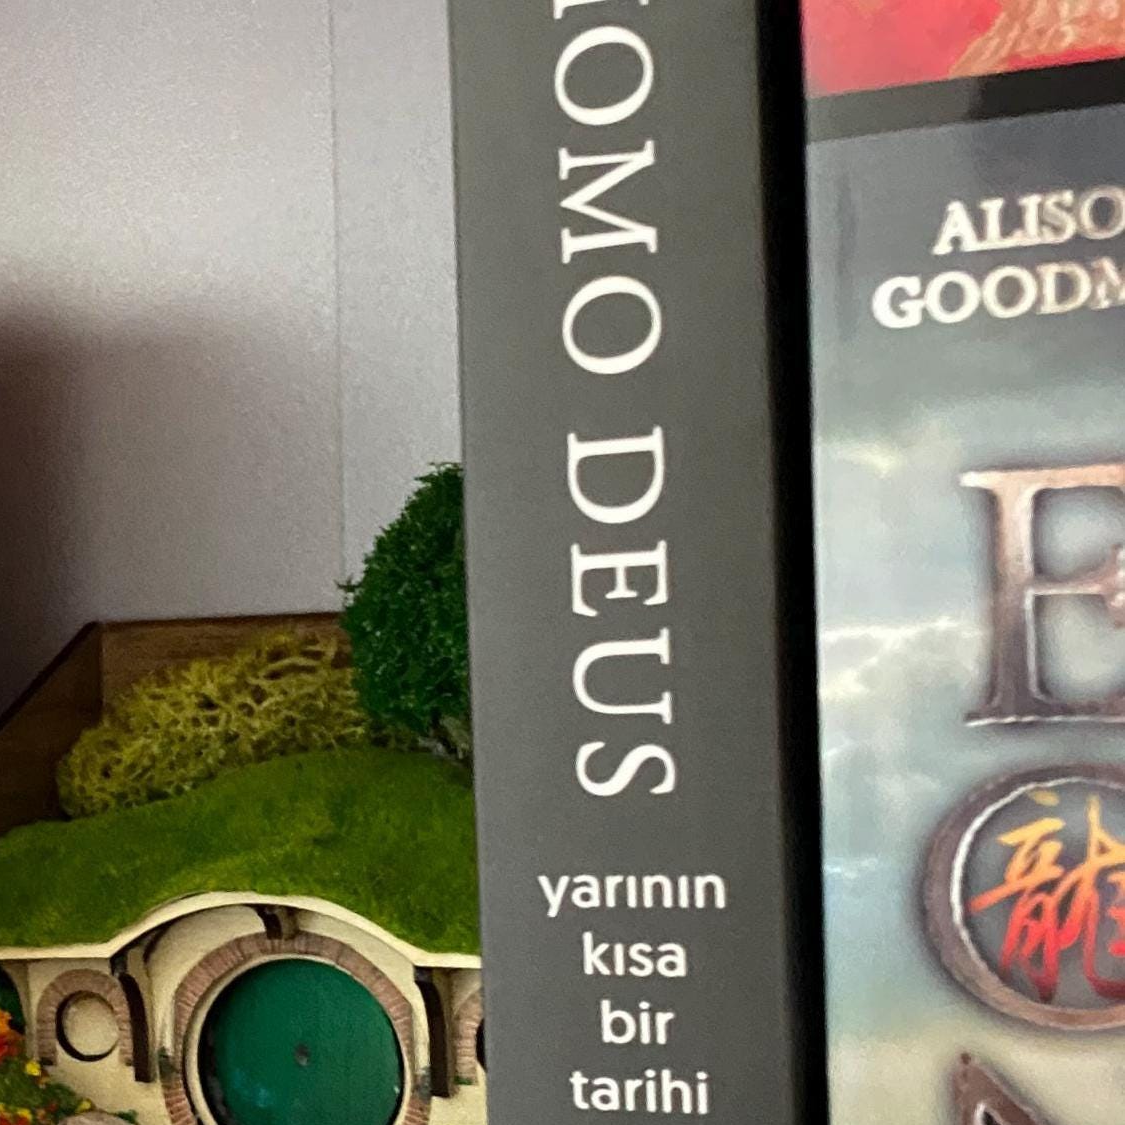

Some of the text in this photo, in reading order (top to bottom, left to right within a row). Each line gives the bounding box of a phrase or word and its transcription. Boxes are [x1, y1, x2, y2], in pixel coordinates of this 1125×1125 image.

[566, 424, 676, 797] DEUS
[536, 873, 727, 918] yarının
[581, 930, 688, 978] kısa
[600, 998, 676, 1045] bir
[568, 1066, 709, 1115] tarihi
